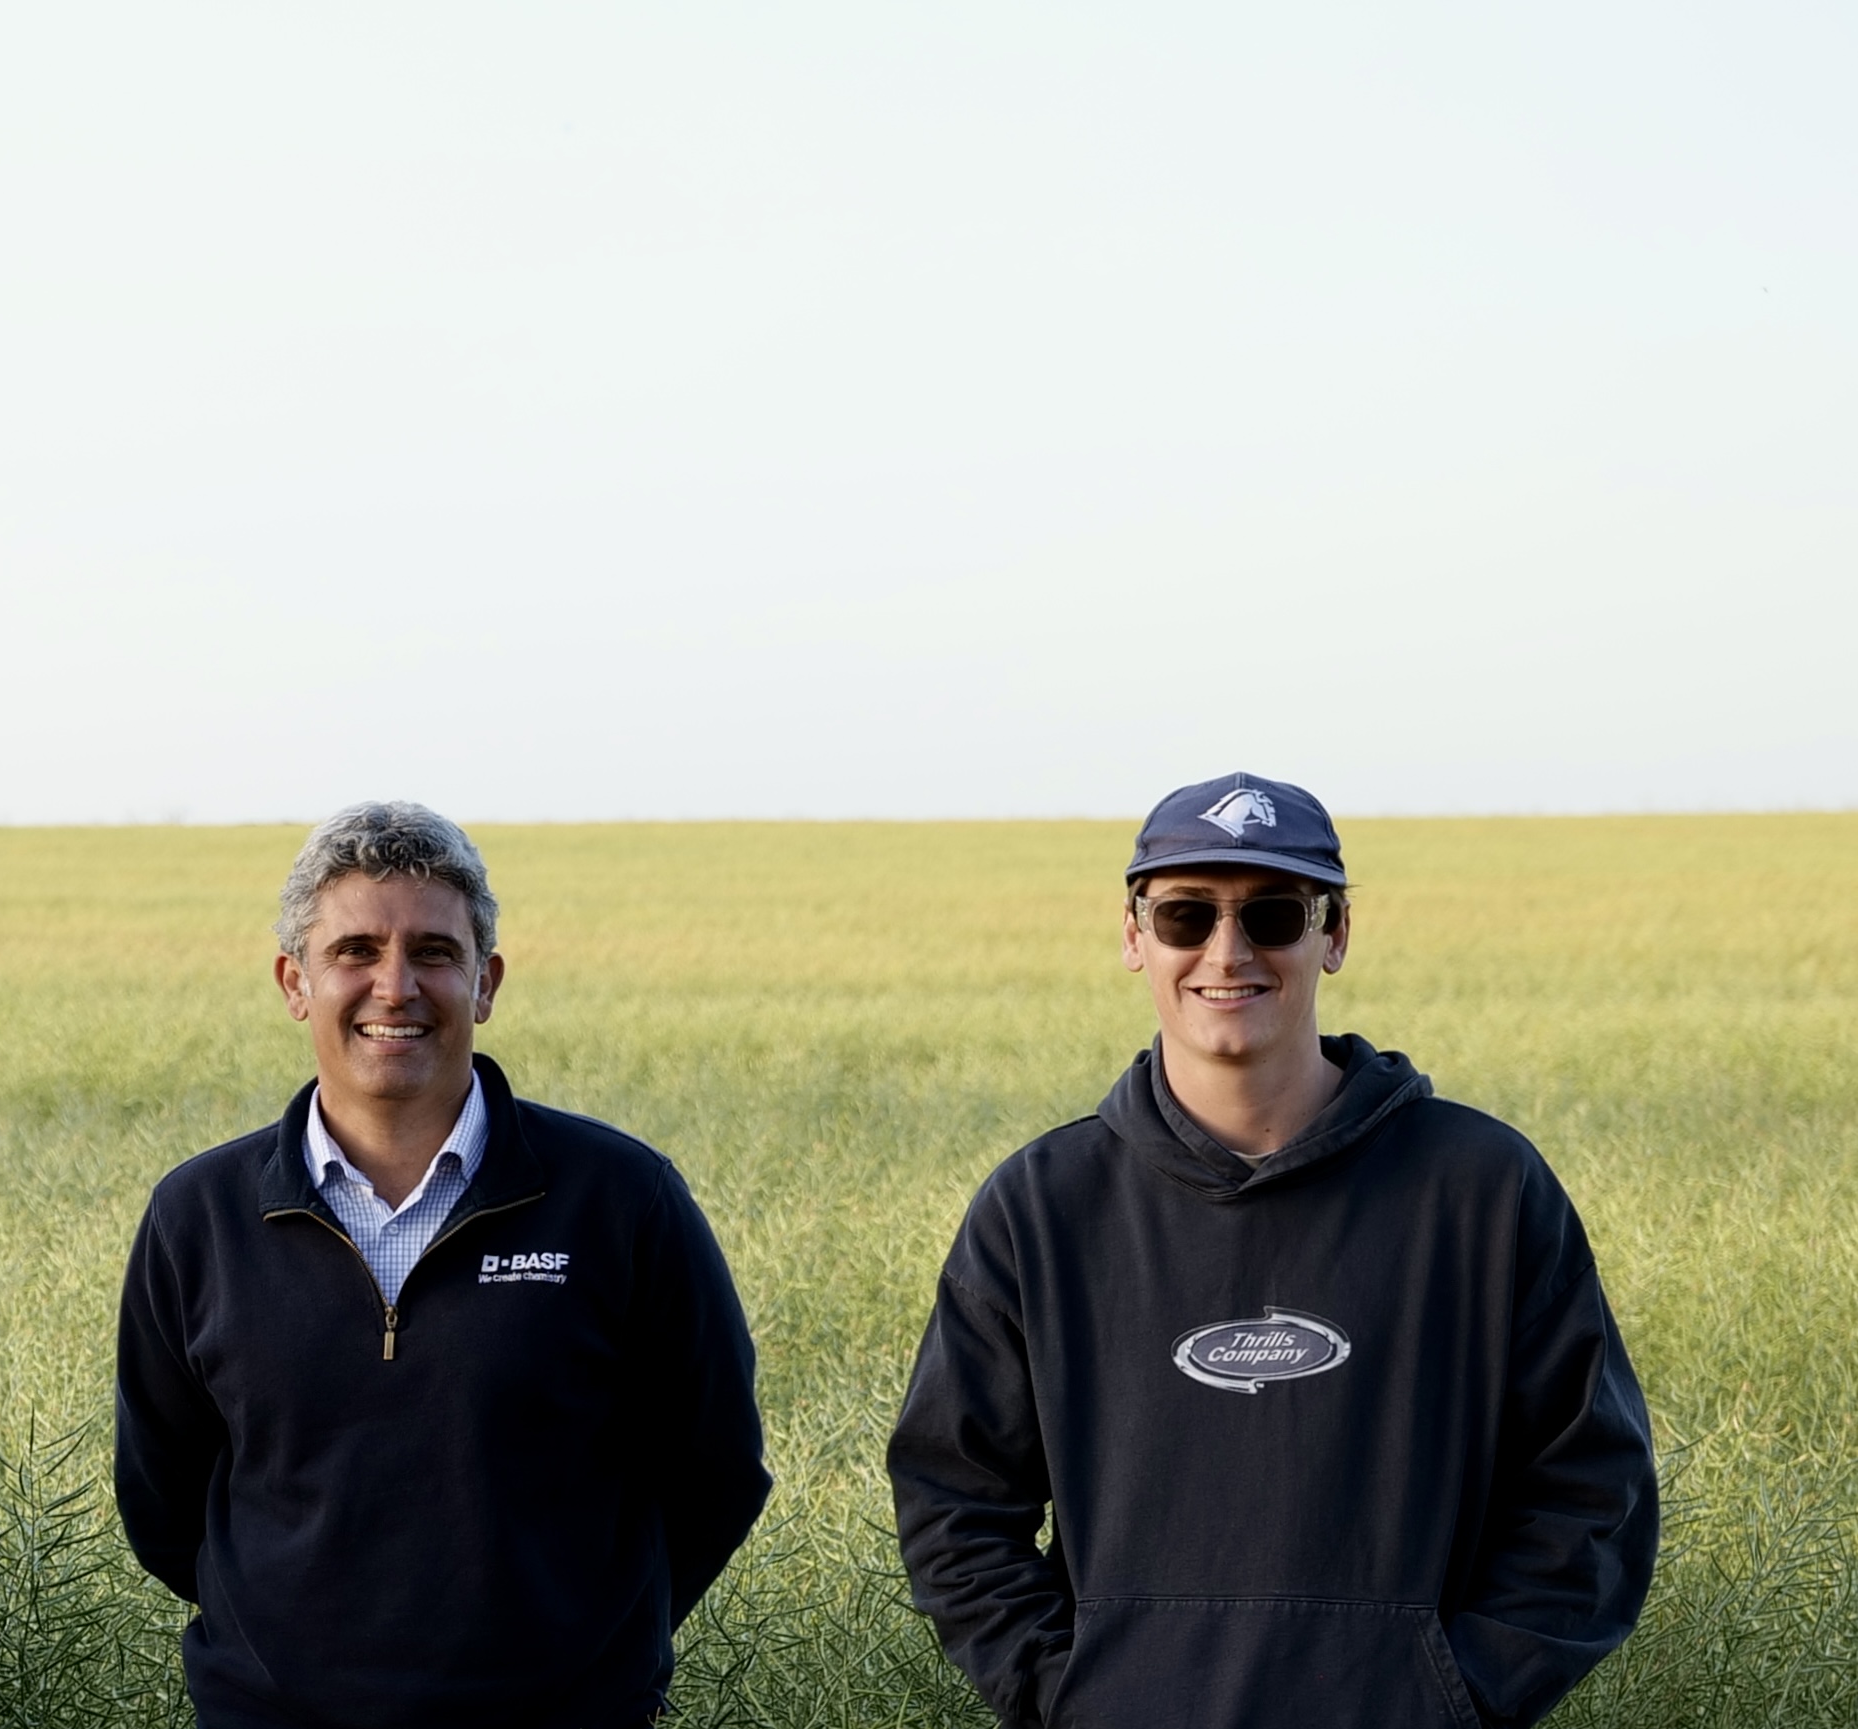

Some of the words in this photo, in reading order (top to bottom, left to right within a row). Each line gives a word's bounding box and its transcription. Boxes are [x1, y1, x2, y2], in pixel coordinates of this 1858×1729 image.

[510, 1252, 570, 1271] BASF
[478, 1274, 492, 1285] We
[492, 1271, 522, 1283] create
[523, 1270, 567, 1285] chemistry
[1230, 1331, 1297, 1348] Thrills
[1207, 1346, 1309, 1366] Company
